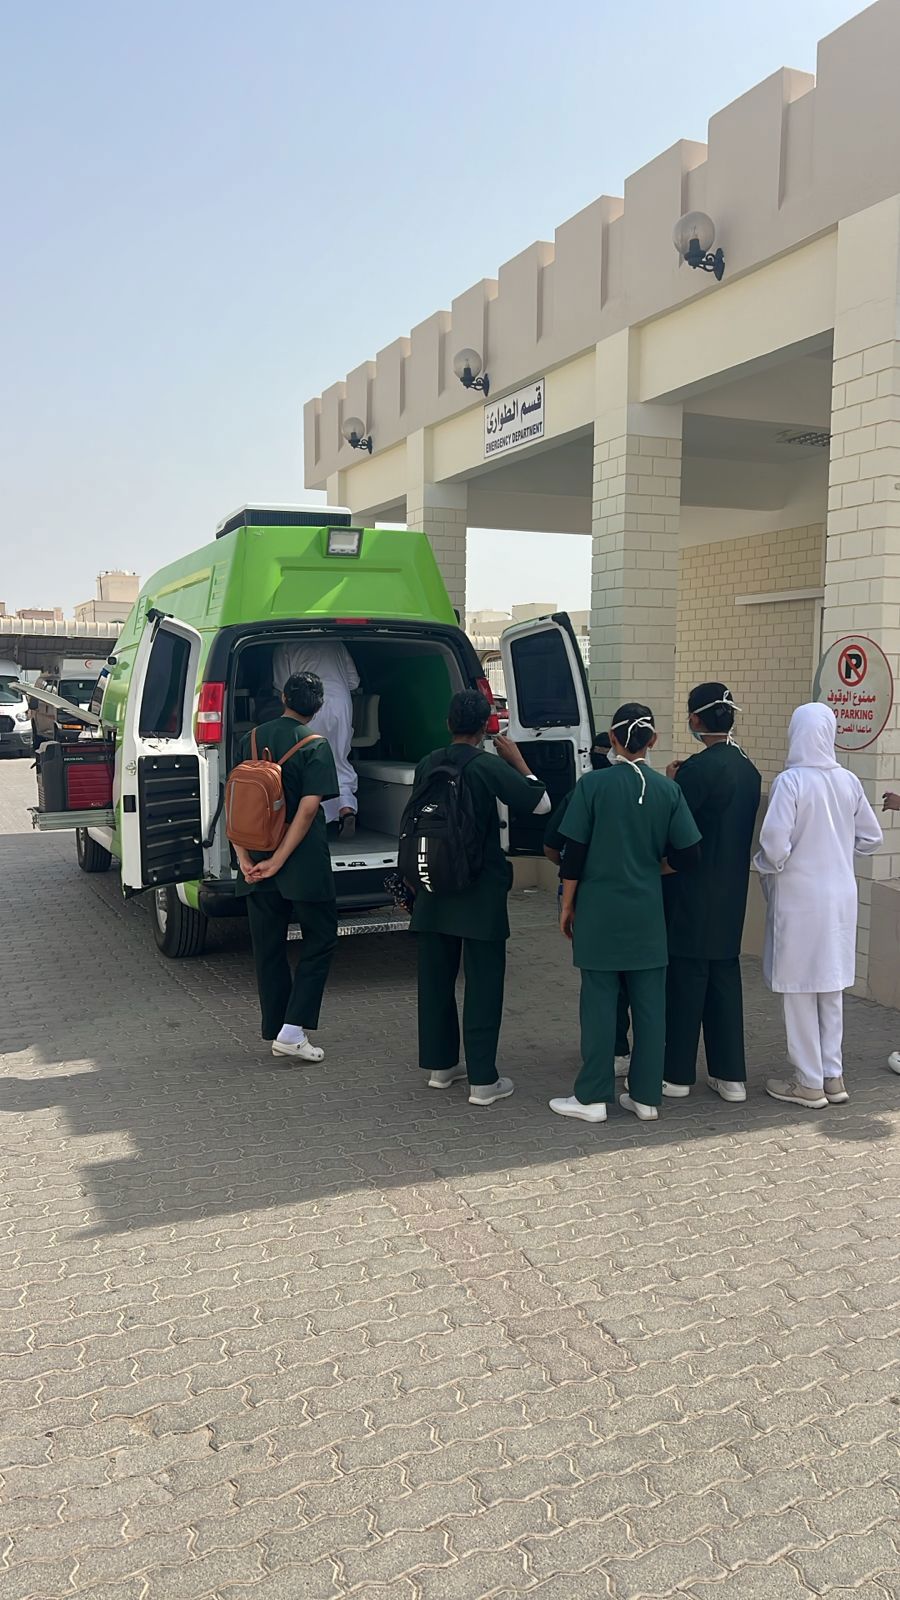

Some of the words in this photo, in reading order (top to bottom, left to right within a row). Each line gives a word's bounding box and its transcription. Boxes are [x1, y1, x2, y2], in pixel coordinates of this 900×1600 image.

[521, 386, 542, 422] قسم
[486, 434, 511, 453] EMERGENCY
[512, 421, 542, 443] DEPARTMENT
[827, 689, 851, 705] الوقوف
[853, 690, 876, 706] ممنوع
[840, 709, 873, 720] PARKING
